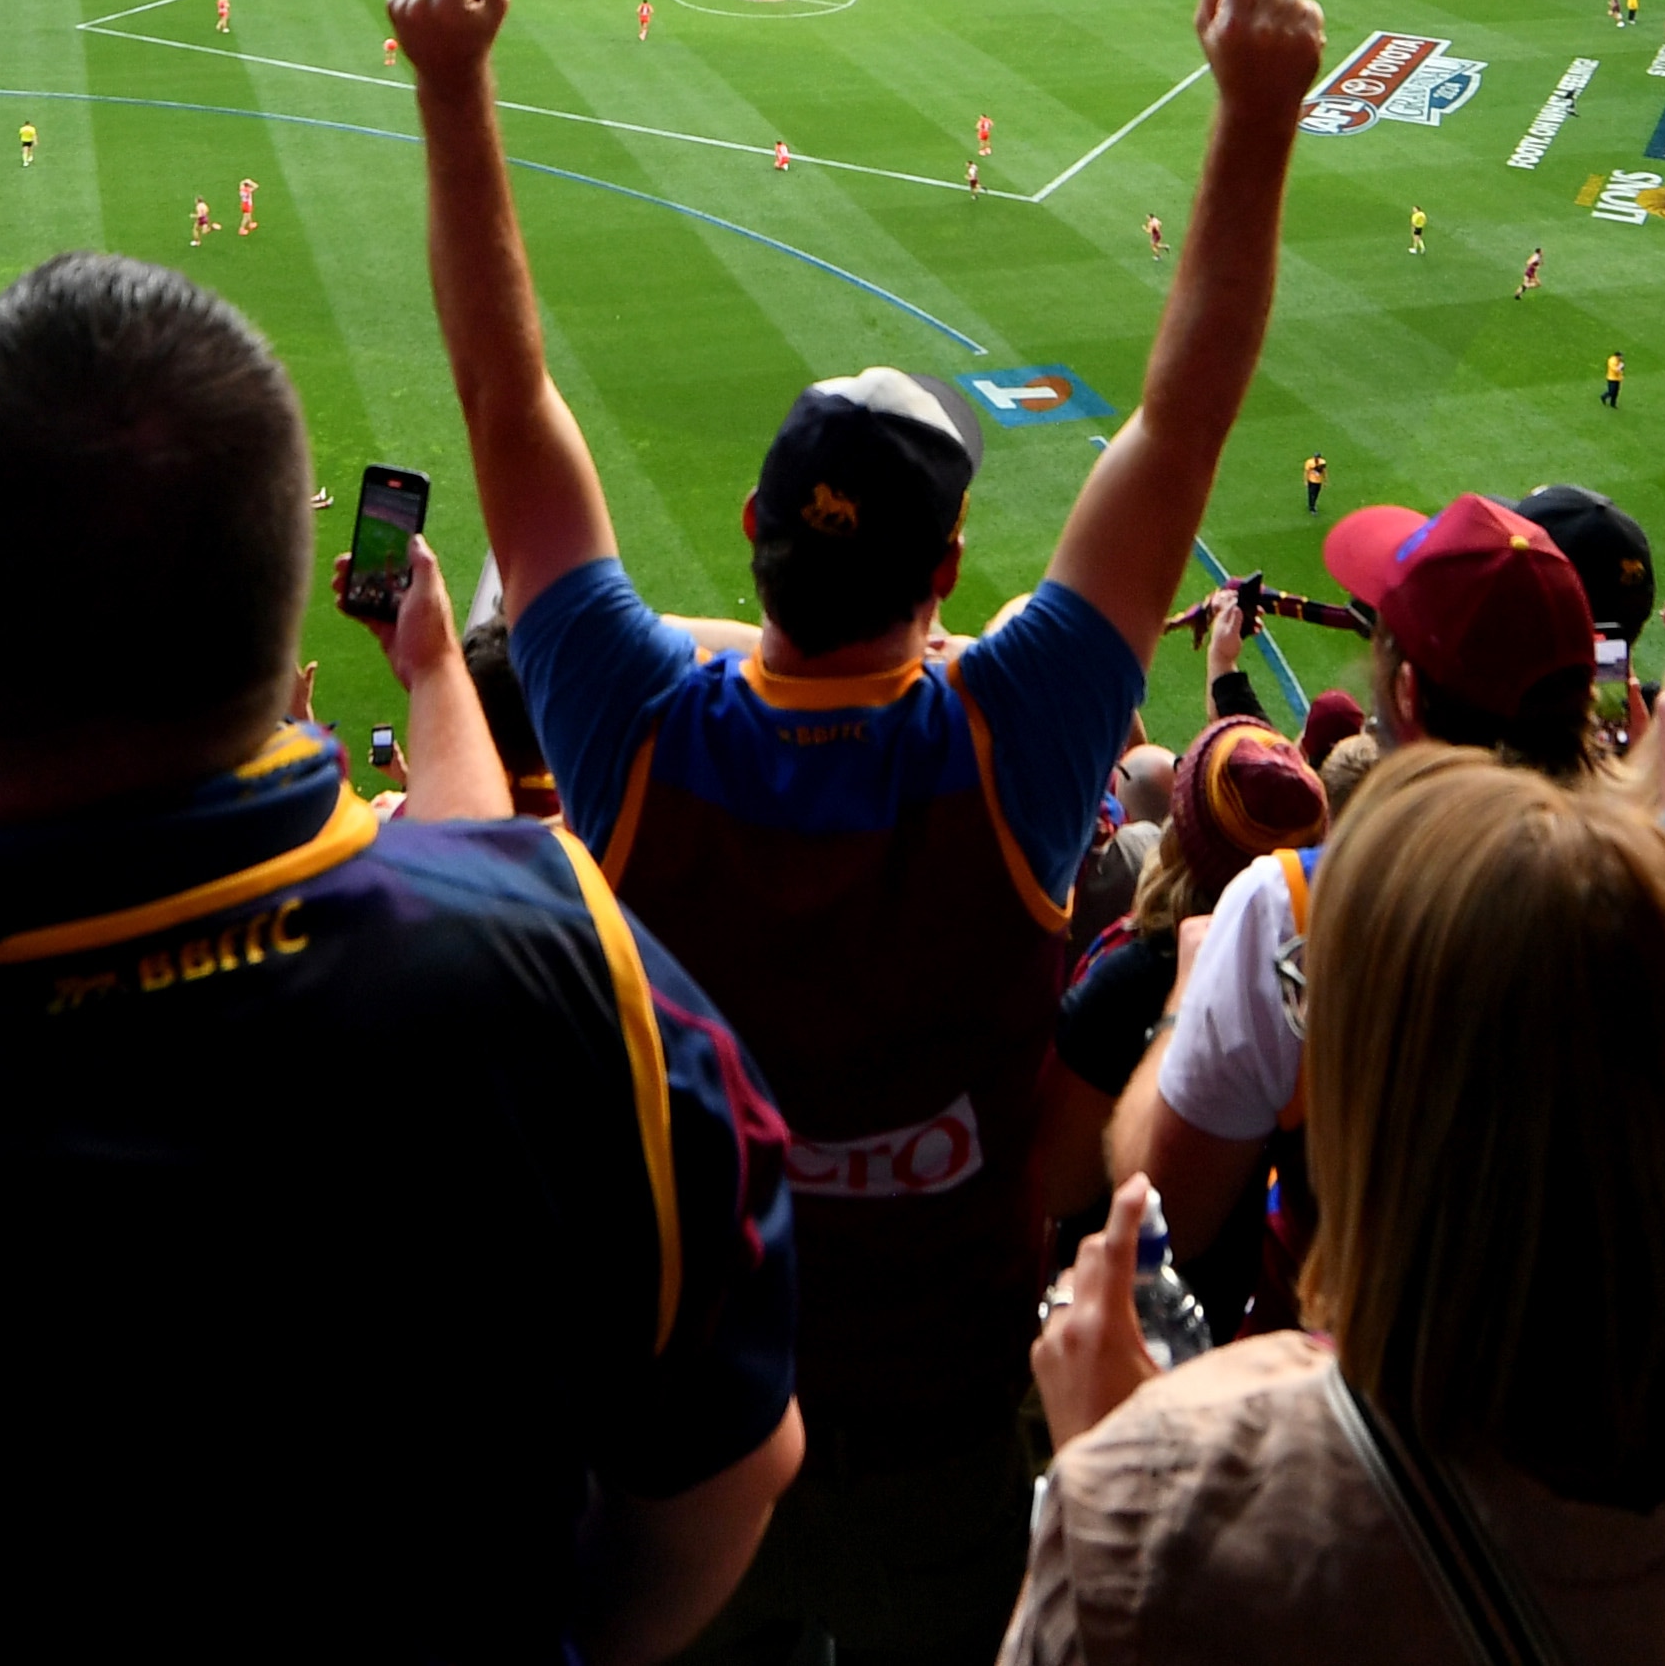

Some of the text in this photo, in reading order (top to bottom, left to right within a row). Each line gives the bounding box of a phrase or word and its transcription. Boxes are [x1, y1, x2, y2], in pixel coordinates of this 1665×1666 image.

[1359, 39, 1426, 78] TOYOTA
[1303, 100, 1366, 133] AFL
[1592, 169, 1663, 226] LIONS
[786, 1116, 971, 1189] ero
